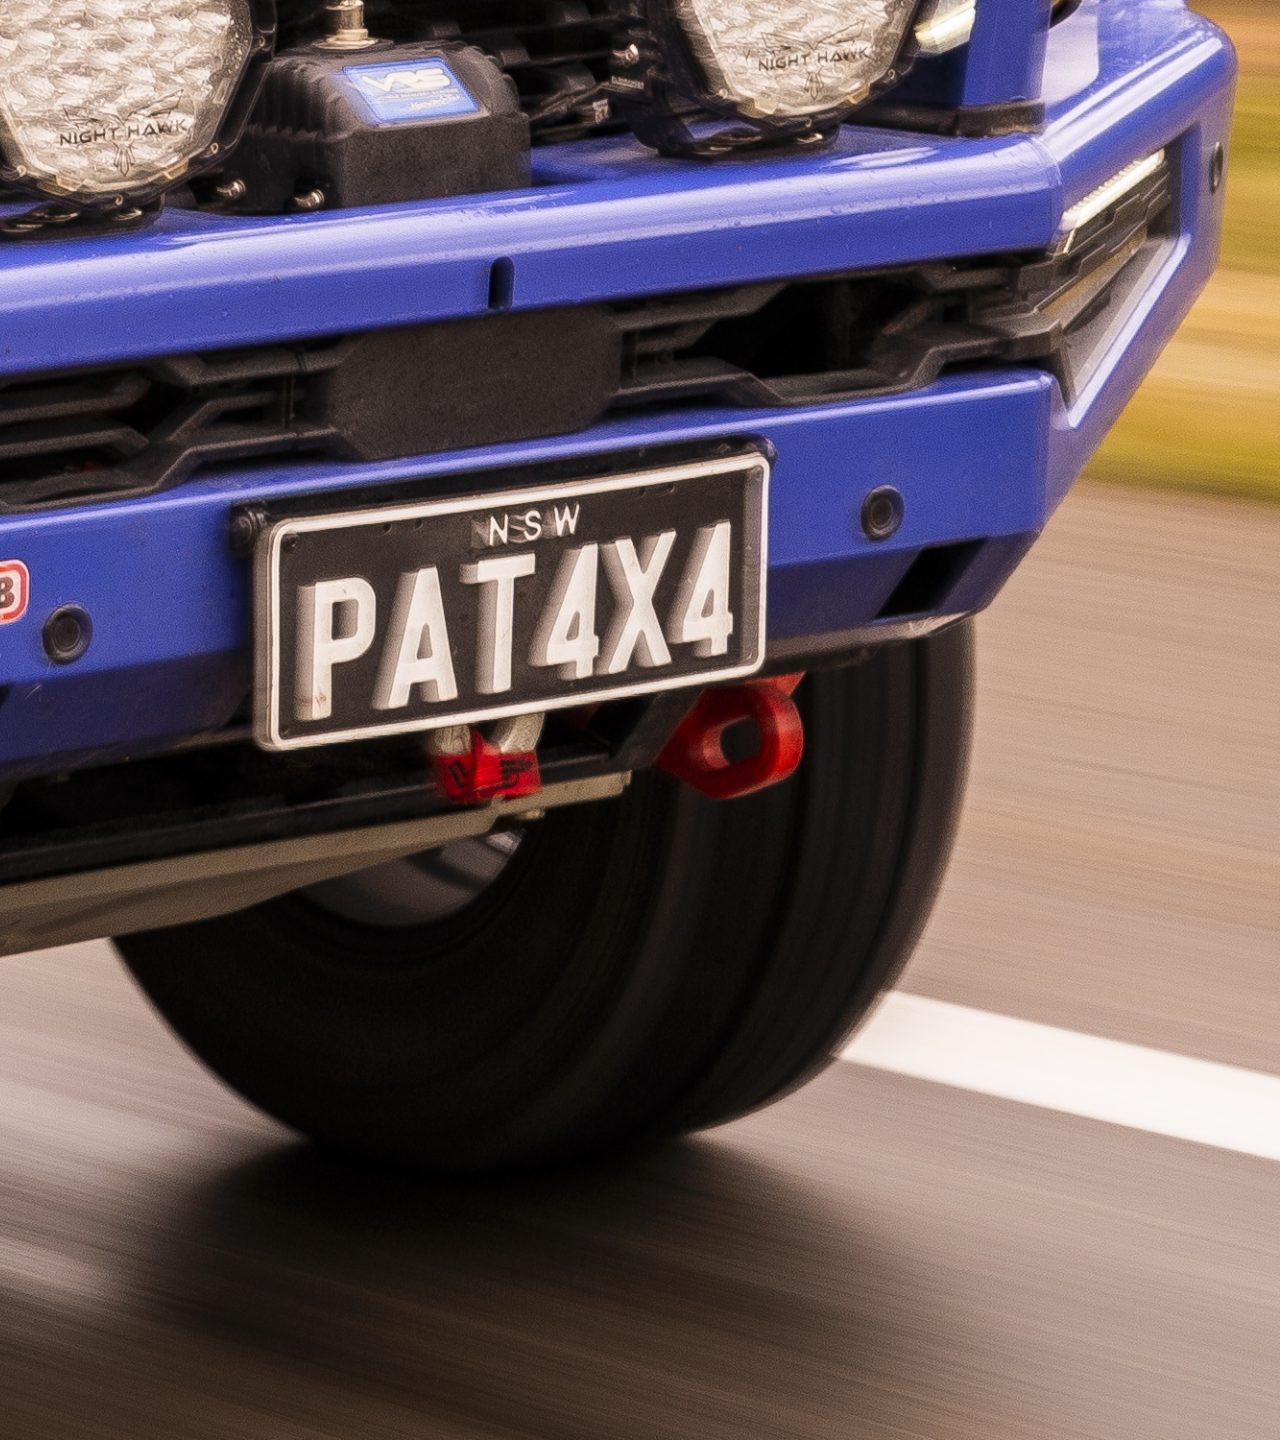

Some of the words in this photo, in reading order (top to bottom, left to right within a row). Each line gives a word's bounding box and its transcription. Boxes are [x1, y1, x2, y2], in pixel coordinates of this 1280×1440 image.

[758, 52, 811, 72] NIGHT
[817, 46, 872, 63] HAWK
[59, 126, 120, 146] NIGHT
[127, 118, 189, 138] HAWK
[302, 519, 734, 721] PAT4X4
